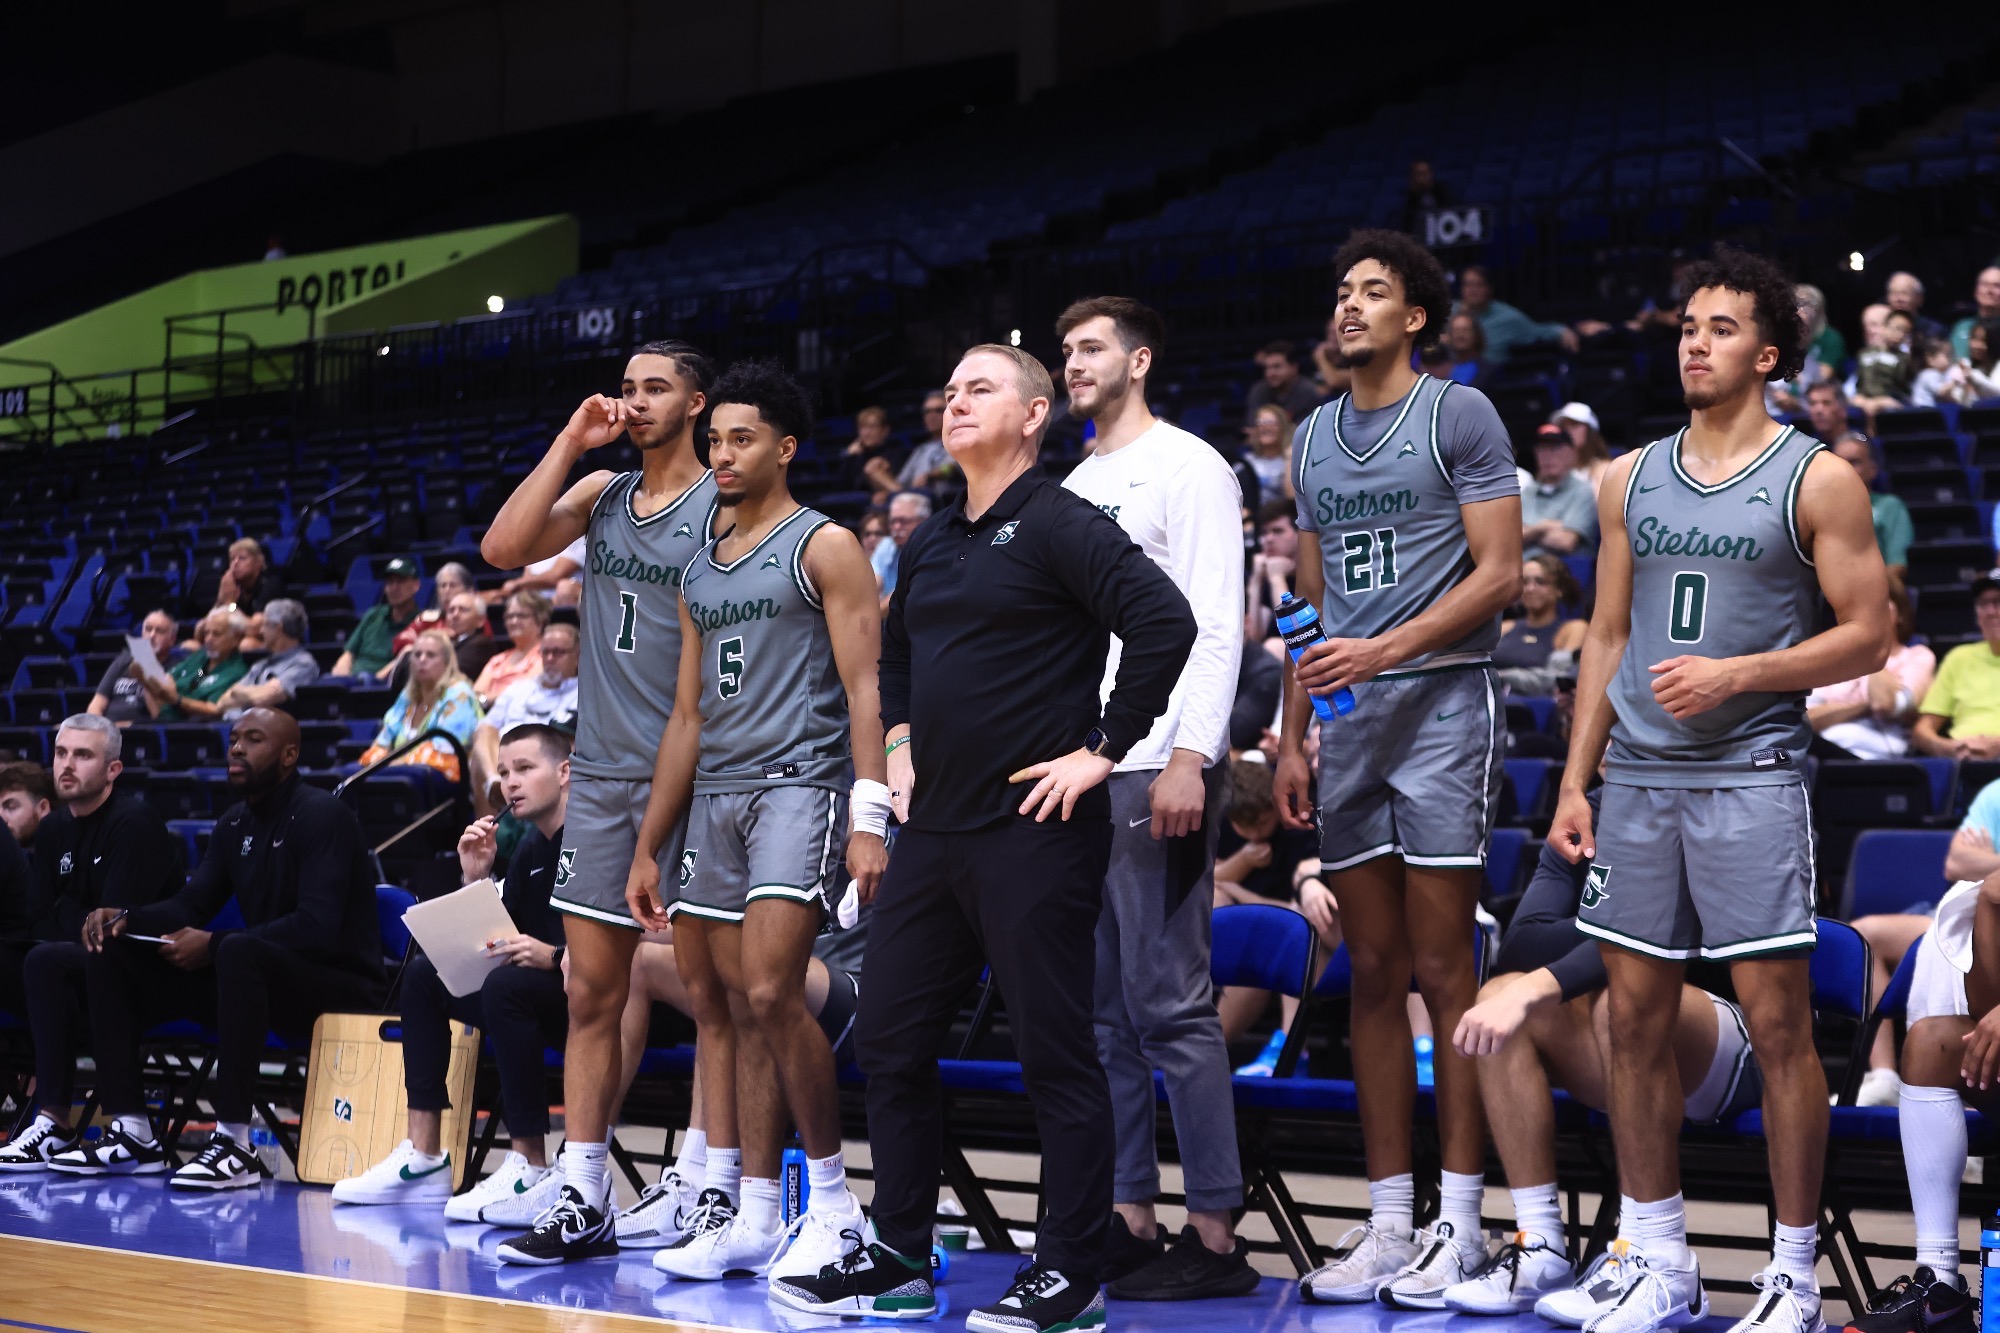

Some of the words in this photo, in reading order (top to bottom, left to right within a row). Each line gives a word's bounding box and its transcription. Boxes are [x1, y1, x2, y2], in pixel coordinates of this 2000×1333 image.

[1425, 208, 1482, 246] 104
[1316, 487, 1420, 526] Stetson
[591, 539, 681, 588] Stetson
[1341, 526, 1399, 595] 21
[1634, 516, 1764, 562] Stetson
[614, 590, 638, 654] 1
[689, 597, 781, 638] Stetson
[1668, 570, 1709, 644] 0
[717, 635, 744, 701] 5
